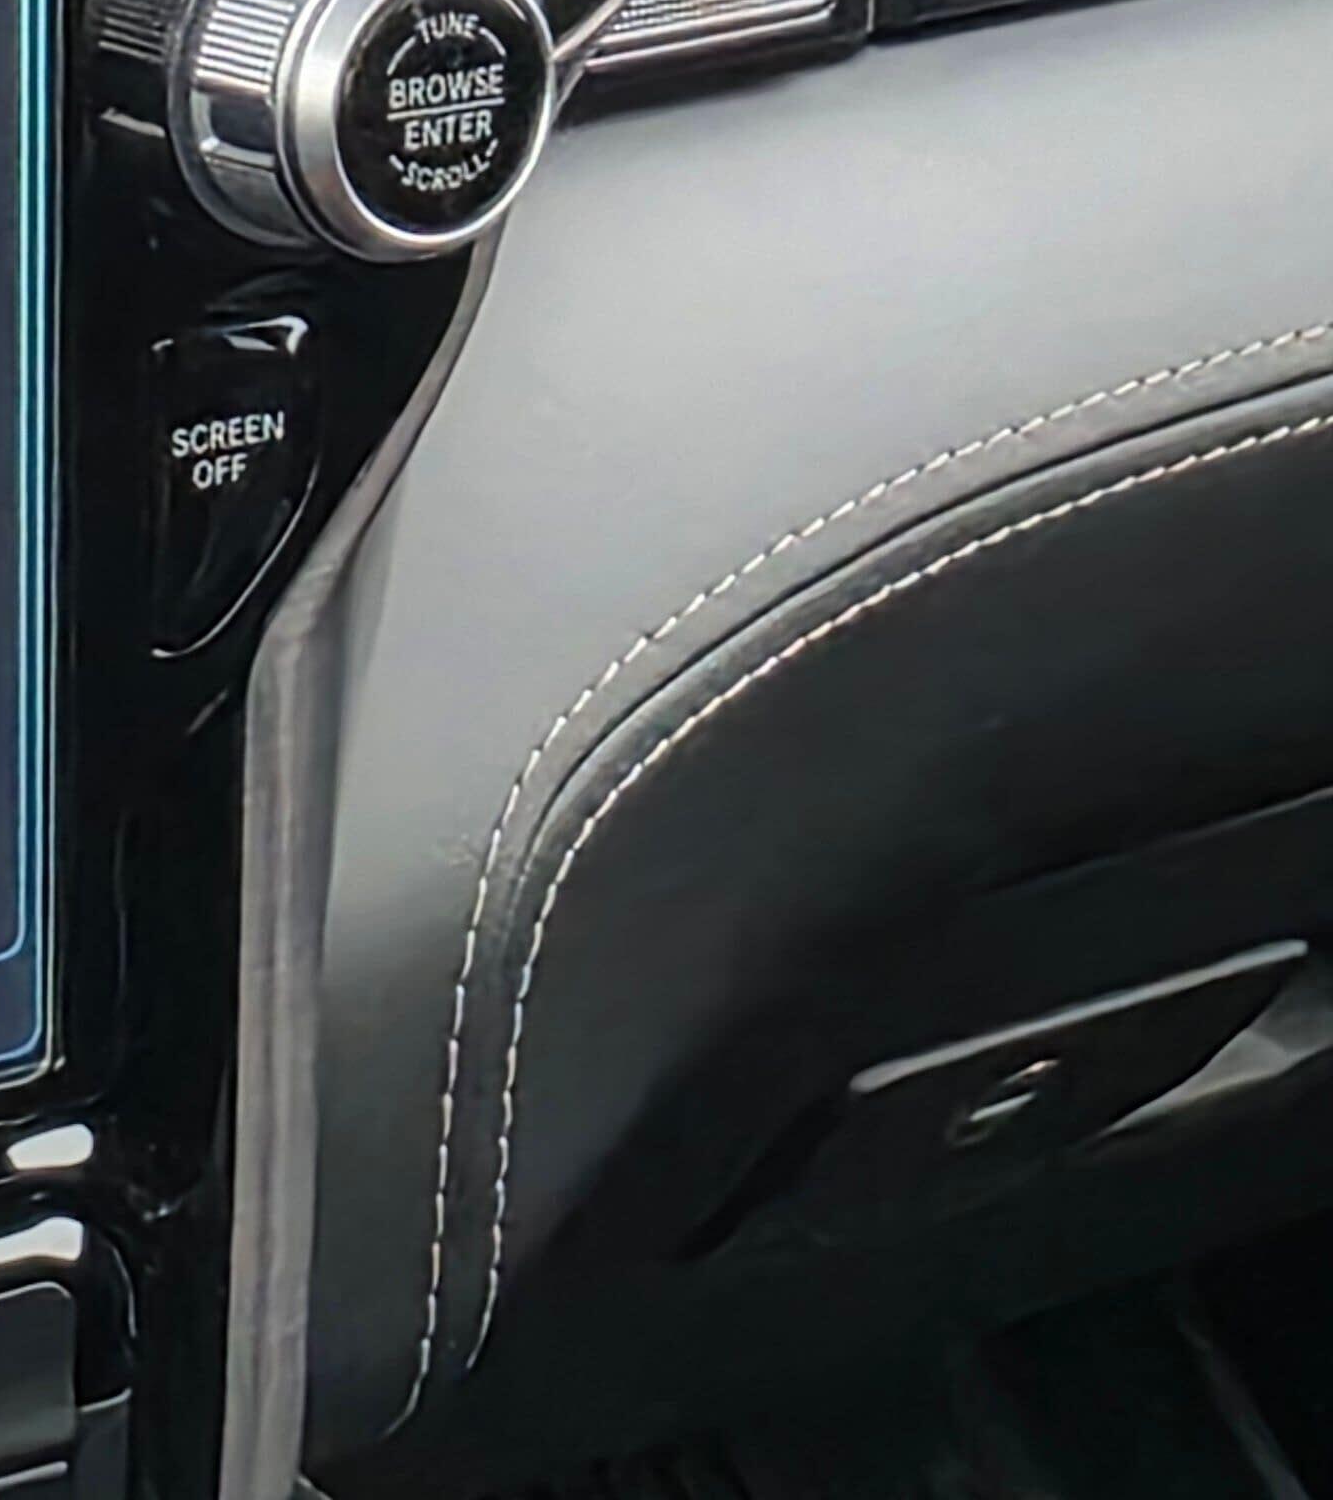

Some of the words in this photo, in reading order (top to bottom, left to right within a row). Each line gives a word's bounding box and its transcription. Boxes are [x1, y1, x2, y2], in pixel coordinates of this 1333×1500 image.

[416, 11, 480, 44] TUNE
[388, 64, 505, 110] BROWSE
[404, 109, 493, 150] ENTER
[401, 153, 490, 192] SCROLL
[171, 410, 285, 458] SCREEN
[192, 452, 248, 490] OFF
